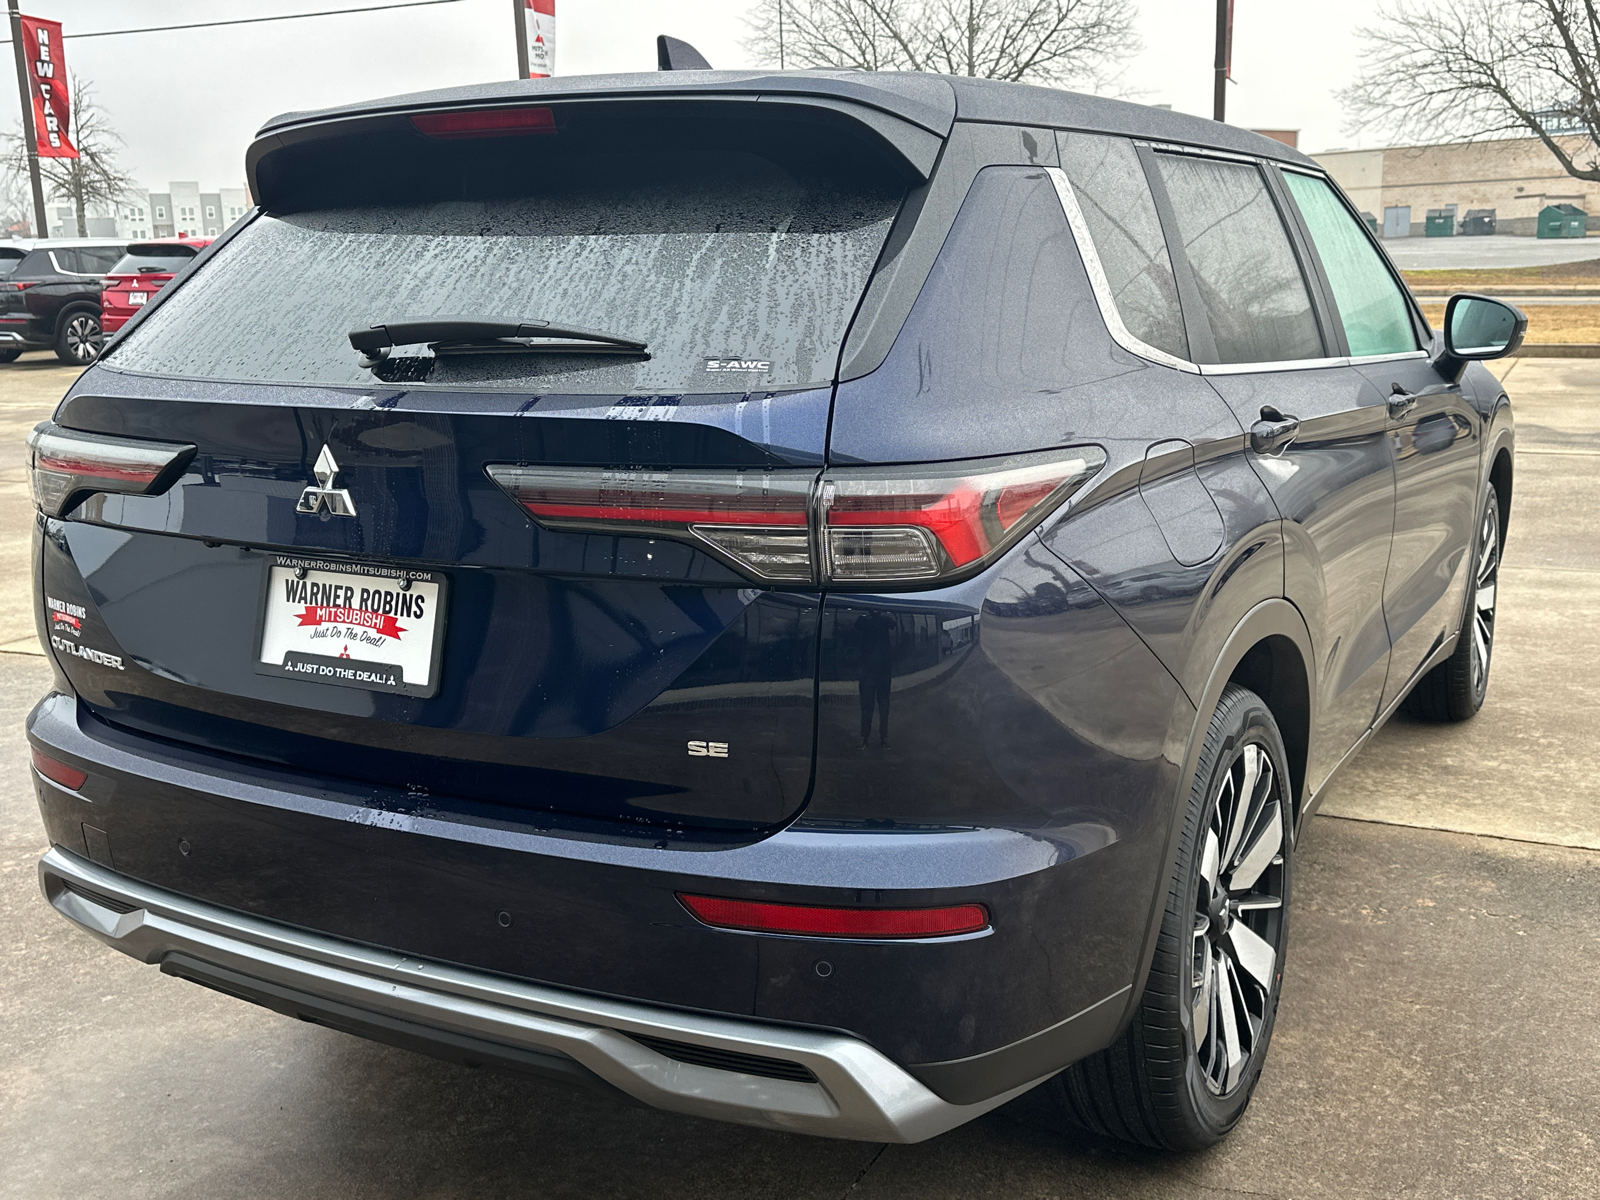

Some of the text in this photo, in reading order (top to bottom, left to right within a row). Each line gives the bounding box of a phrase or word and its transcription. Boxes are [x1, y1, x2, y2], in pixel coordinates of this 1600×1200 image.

[36, 28, 61, 148] NEW CARS
[706, 360, 770, 369] S-AWC
[285, 579, 425, 619] WARNER ROBINS
[316, 608, 385, 630] MITSUBISHI
[310, 625, 387, 648] Just Do The Deal!
[51, 634, 126, 671] OUTLANDER
[294, 663, 386, 684] JUST DO THE DEAL!
[687, 740, 729, 758] SE
